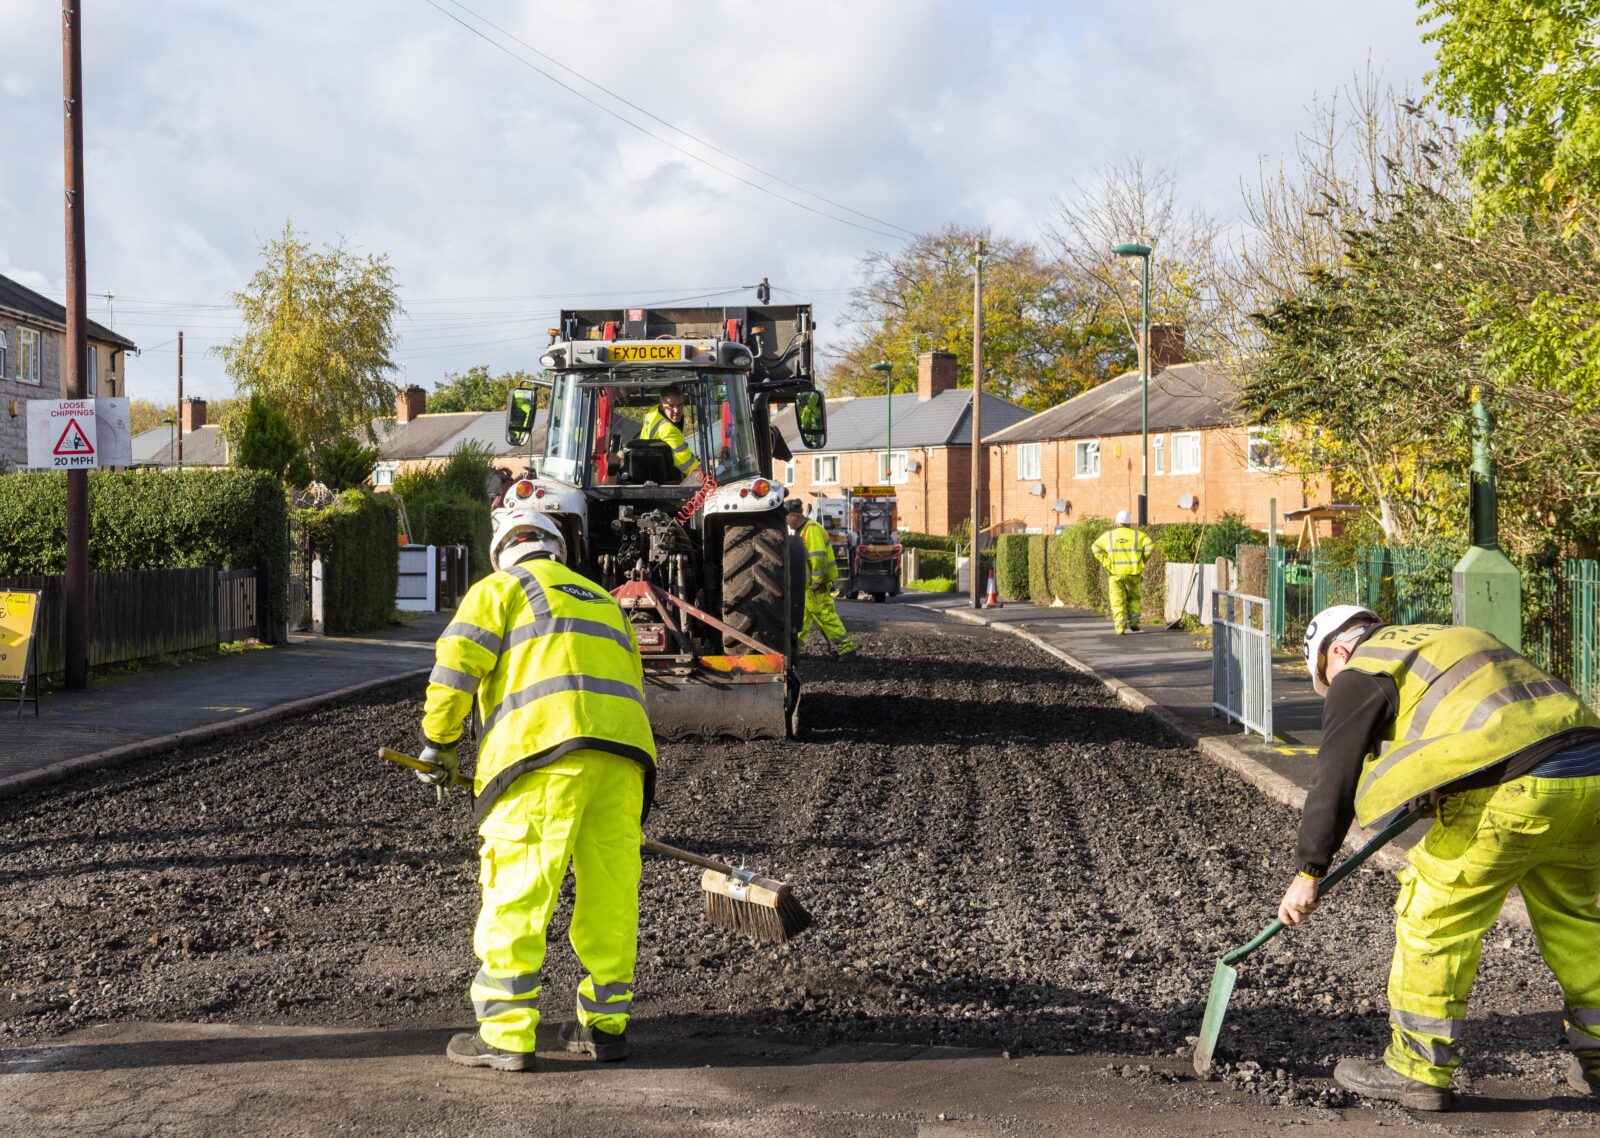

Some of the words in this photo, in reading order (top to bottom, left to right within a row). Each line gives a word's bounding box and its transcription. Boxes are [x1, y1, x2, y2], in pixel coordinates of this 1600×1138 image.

[613, 347, 647, 359] FX70
[650, 346, 675, 359] CCK
[59, 402, 85, 410] LOOSE
[54, 457, 68, 466] 20
[70, 456, 94, 465] MPH
[562, 586, 594, 598] COLAS
